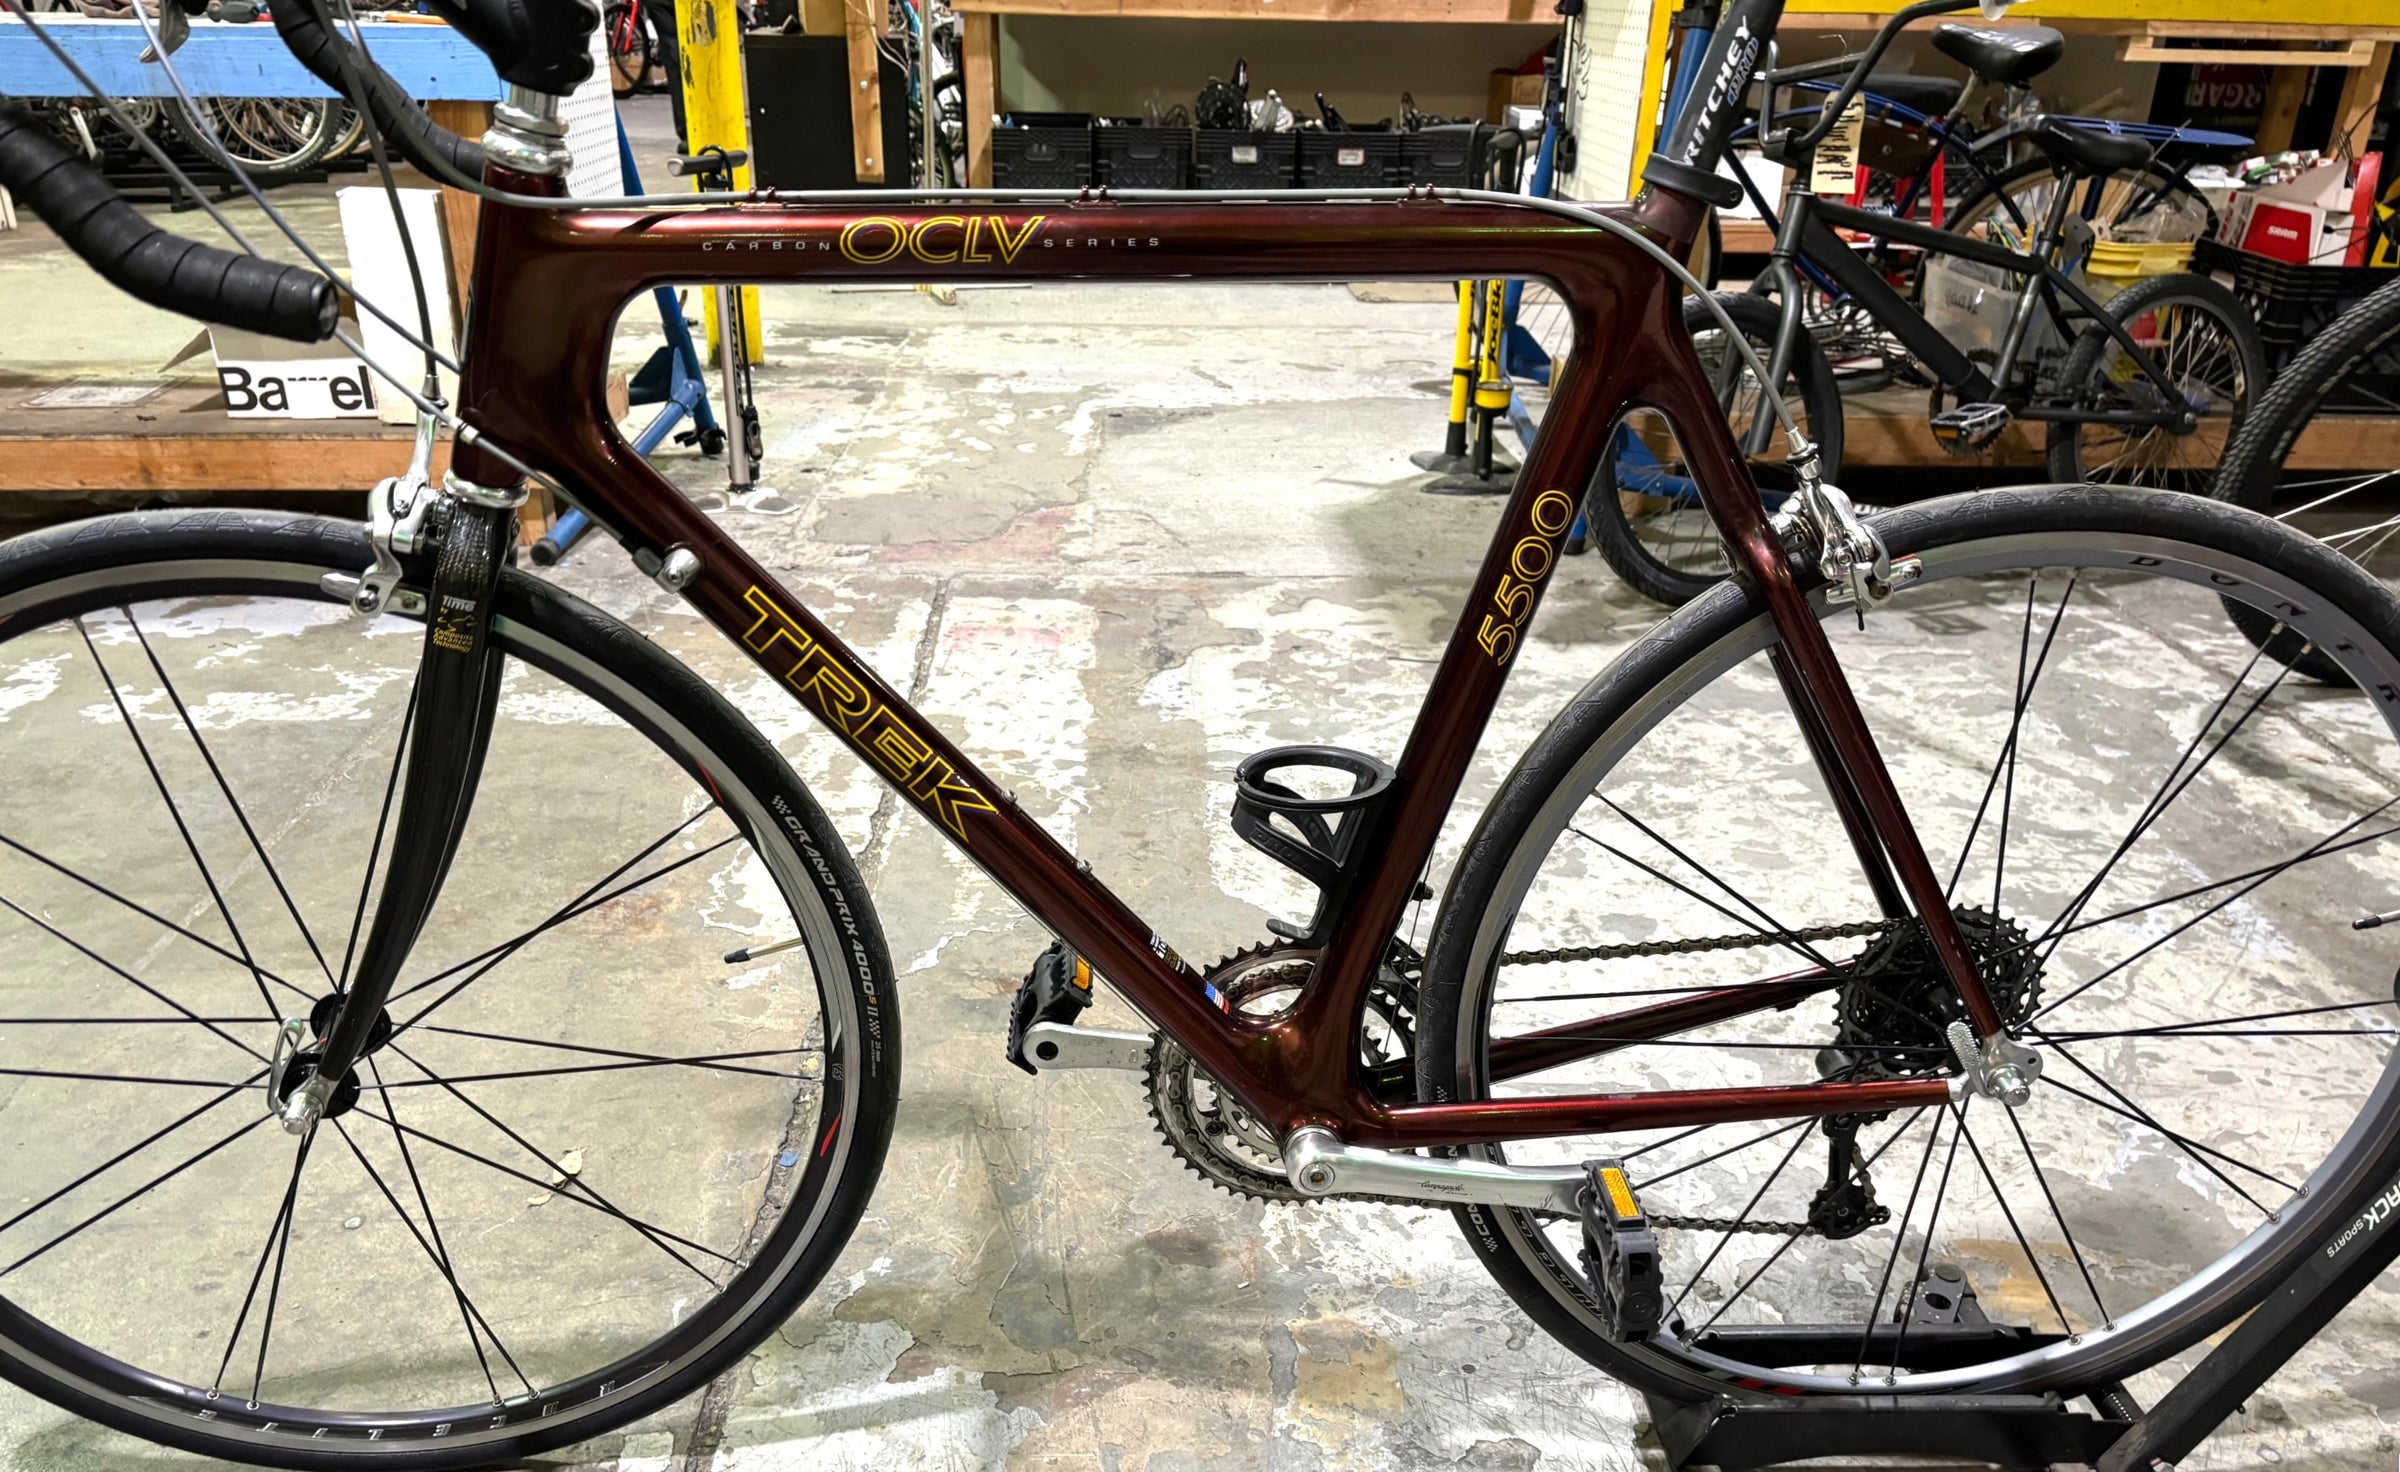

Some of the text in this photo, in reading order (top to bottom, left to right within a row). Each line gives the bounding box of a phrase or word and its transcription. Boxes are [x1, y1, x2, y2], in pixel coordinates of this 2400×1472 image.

[1683, 15, 1750, 166] RITCHEY
[702, 215, 1160, 265] CARBON OCLV SERIES
[2267, 225, 2299, 241] SRAM
[217, 365, 376, 412] Bael
[442, 594, 477, 612] Time
[1477, 489, 1574, 667] 5500
[742, 585, 999, 843] TREK
[784, 815, 837, 887] GRAND
[829, 887, 859, 936] PRIX
[2326, 1178, 2400, 1258] ACK SPORTS
